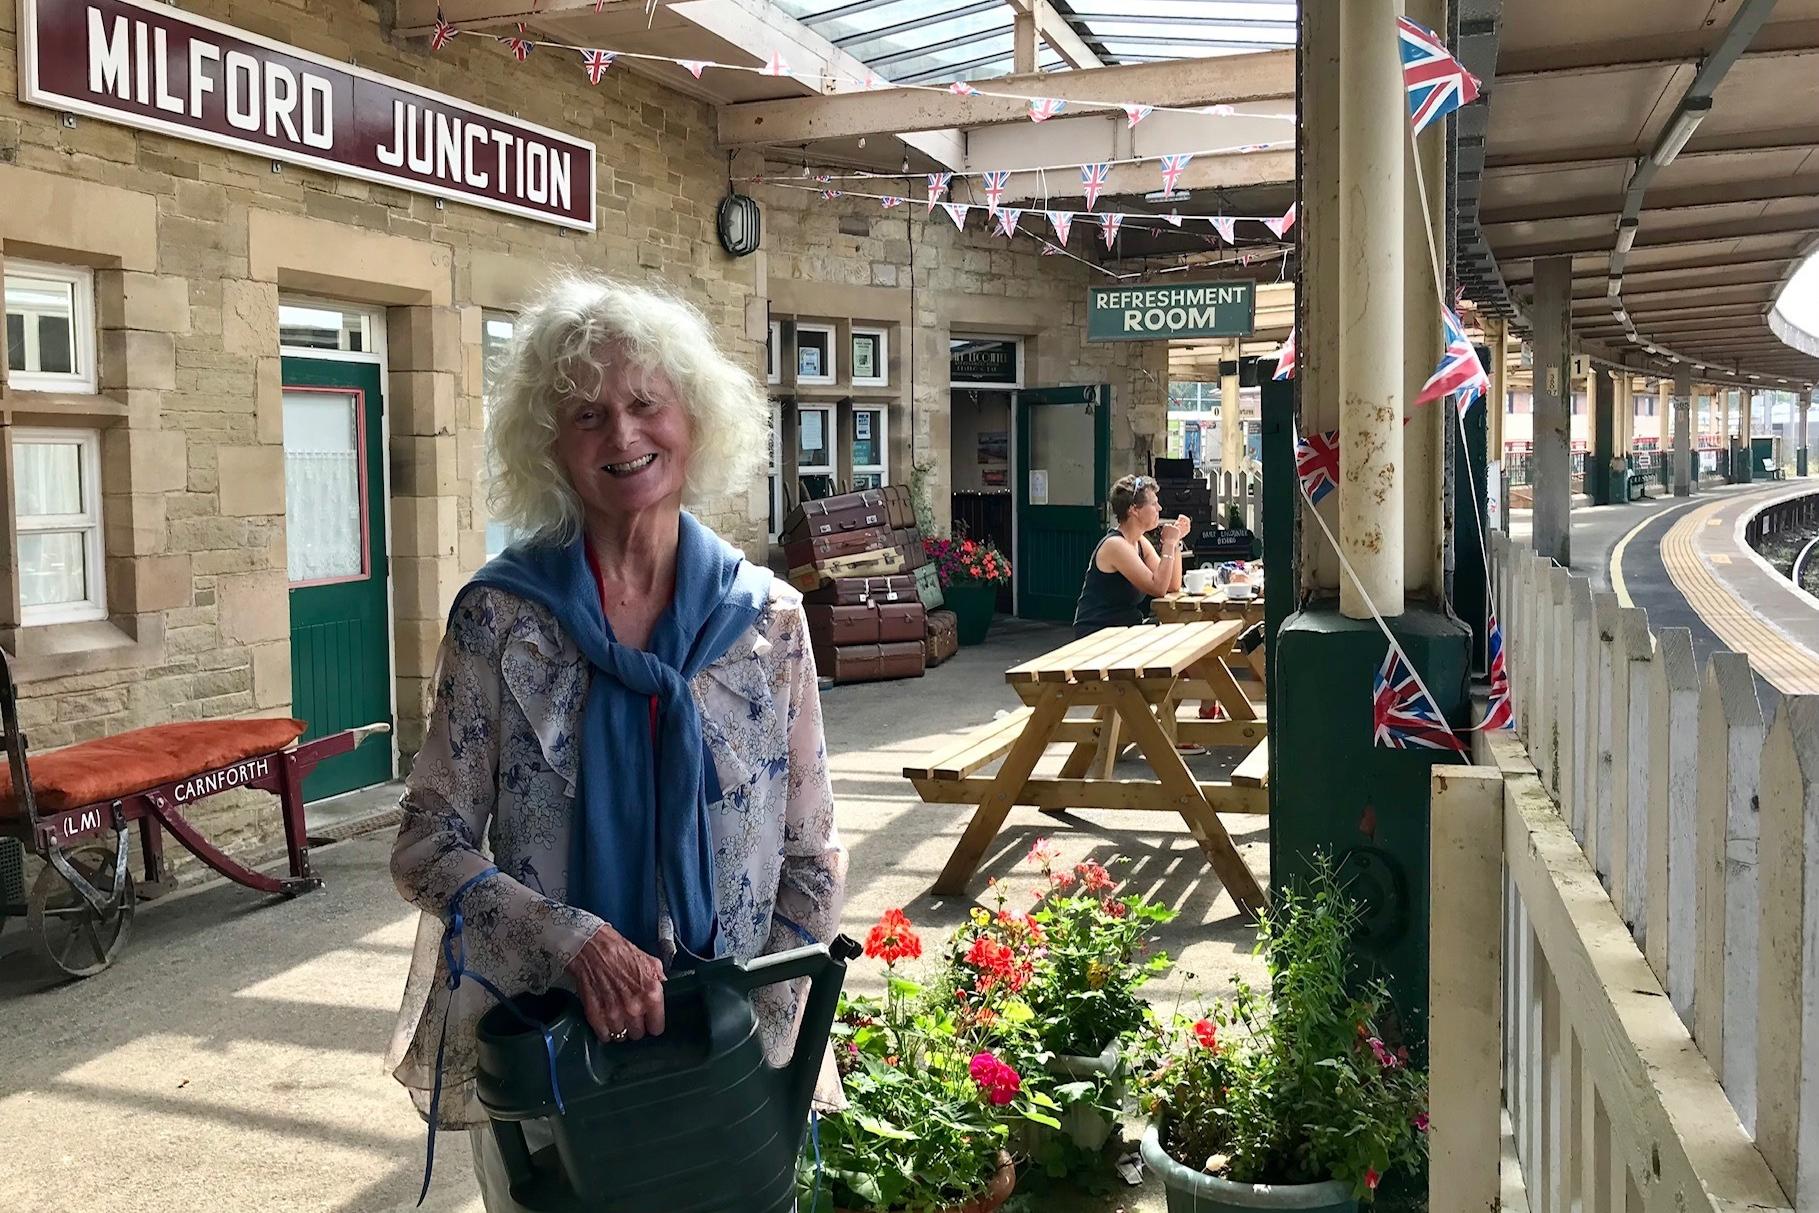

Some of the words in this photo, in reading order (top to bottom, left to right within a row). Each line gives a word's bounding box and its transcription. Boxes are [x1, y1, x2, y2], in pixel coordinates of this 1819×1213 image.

[87, 6, 334, 150] MILFORD
[376, 99, 572, 210] JUNCTION
[1096, 286, 1247, 310] REFRESHMENT
[1123, 306, 1216, 332] ROOM
[1574, 359, 1581, 375] 1
[174, 758, 269, 801] CARNFORTH
